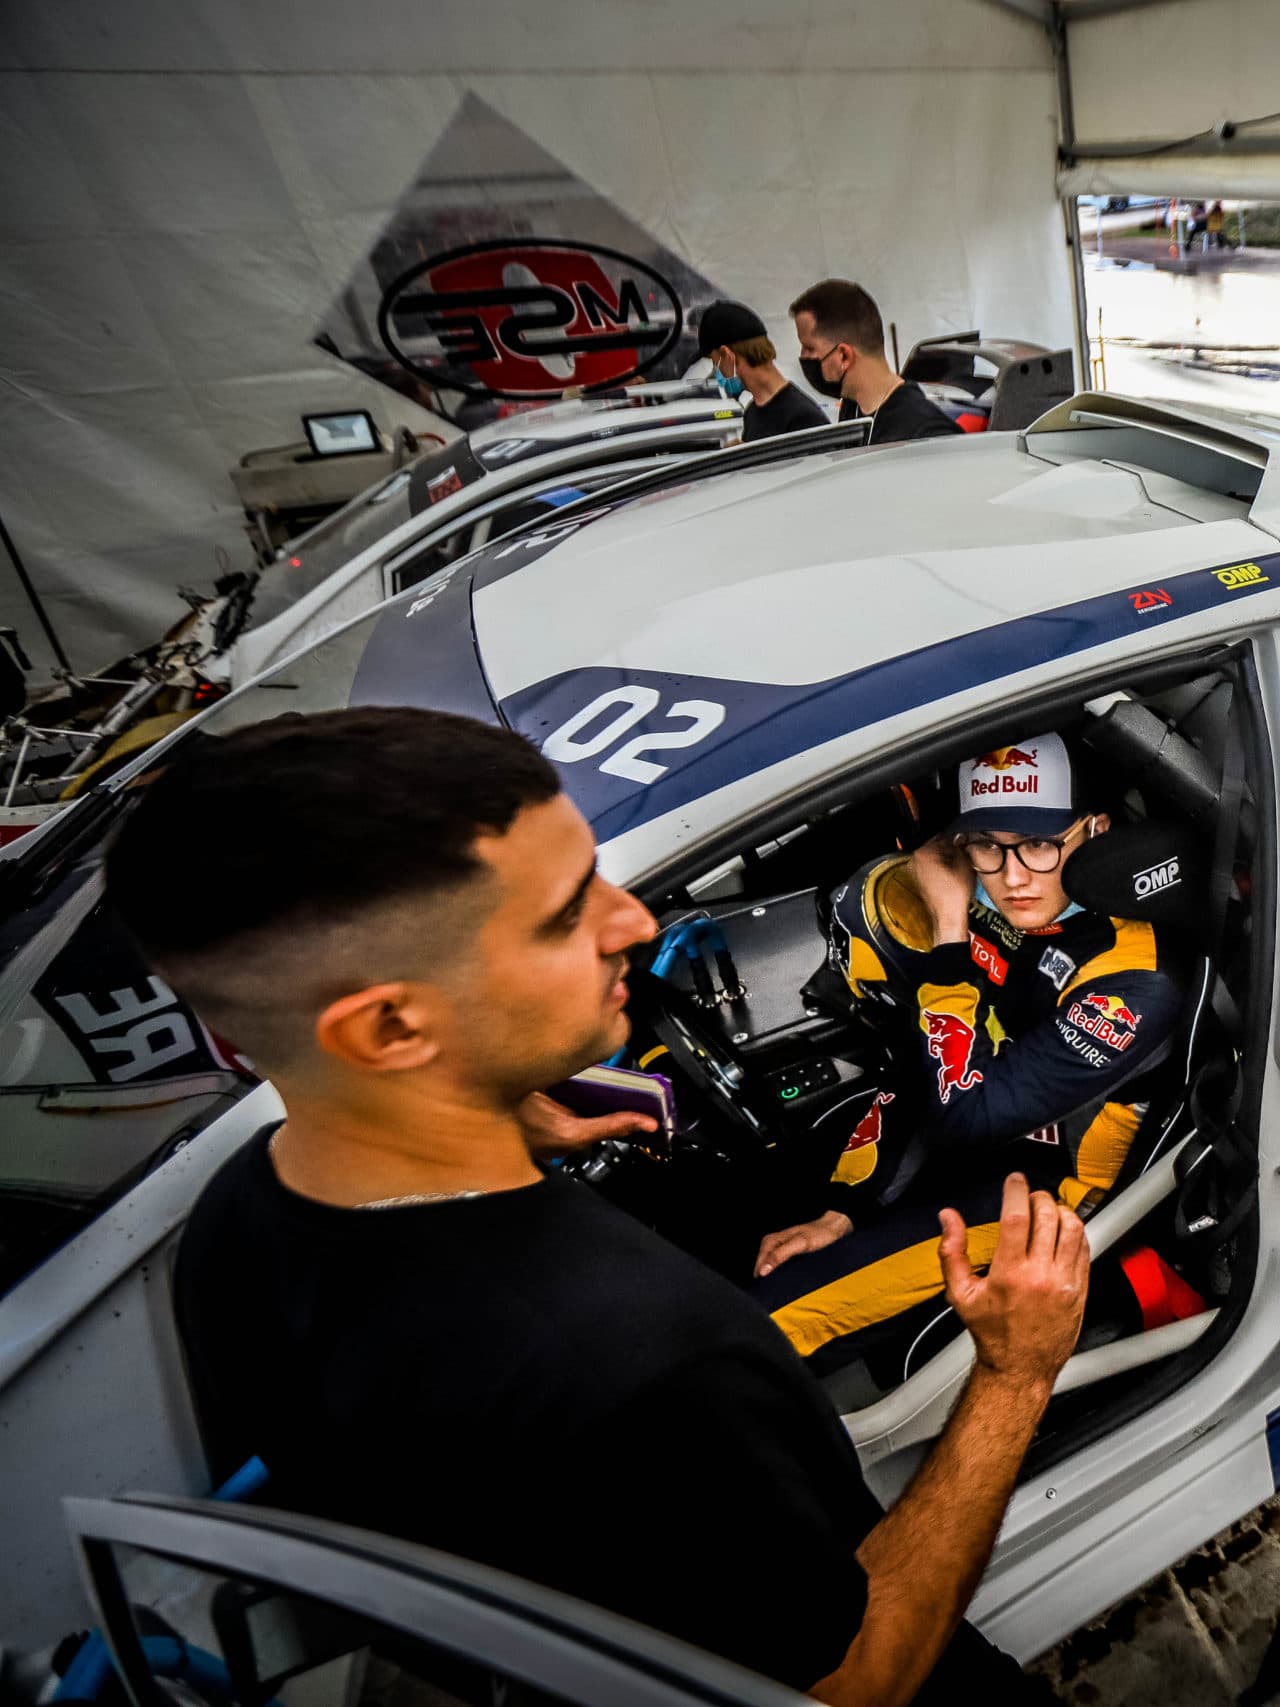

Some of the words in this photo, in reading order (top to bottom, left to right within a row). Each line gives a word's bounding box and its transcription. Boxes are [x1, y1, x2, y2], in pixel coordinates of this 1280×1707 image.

[1216, 564, 1263, 586] OMP
[540, 685, 727, 785] 02
[971, 775, 1000, 797] Red
[1002, 775, 1039, 794] Bull
[1134, 861, 1180, 895] OMP
[1067, 1002, 1102, 1035] Red
[1094, 1018, 1135, 1052] Bull
